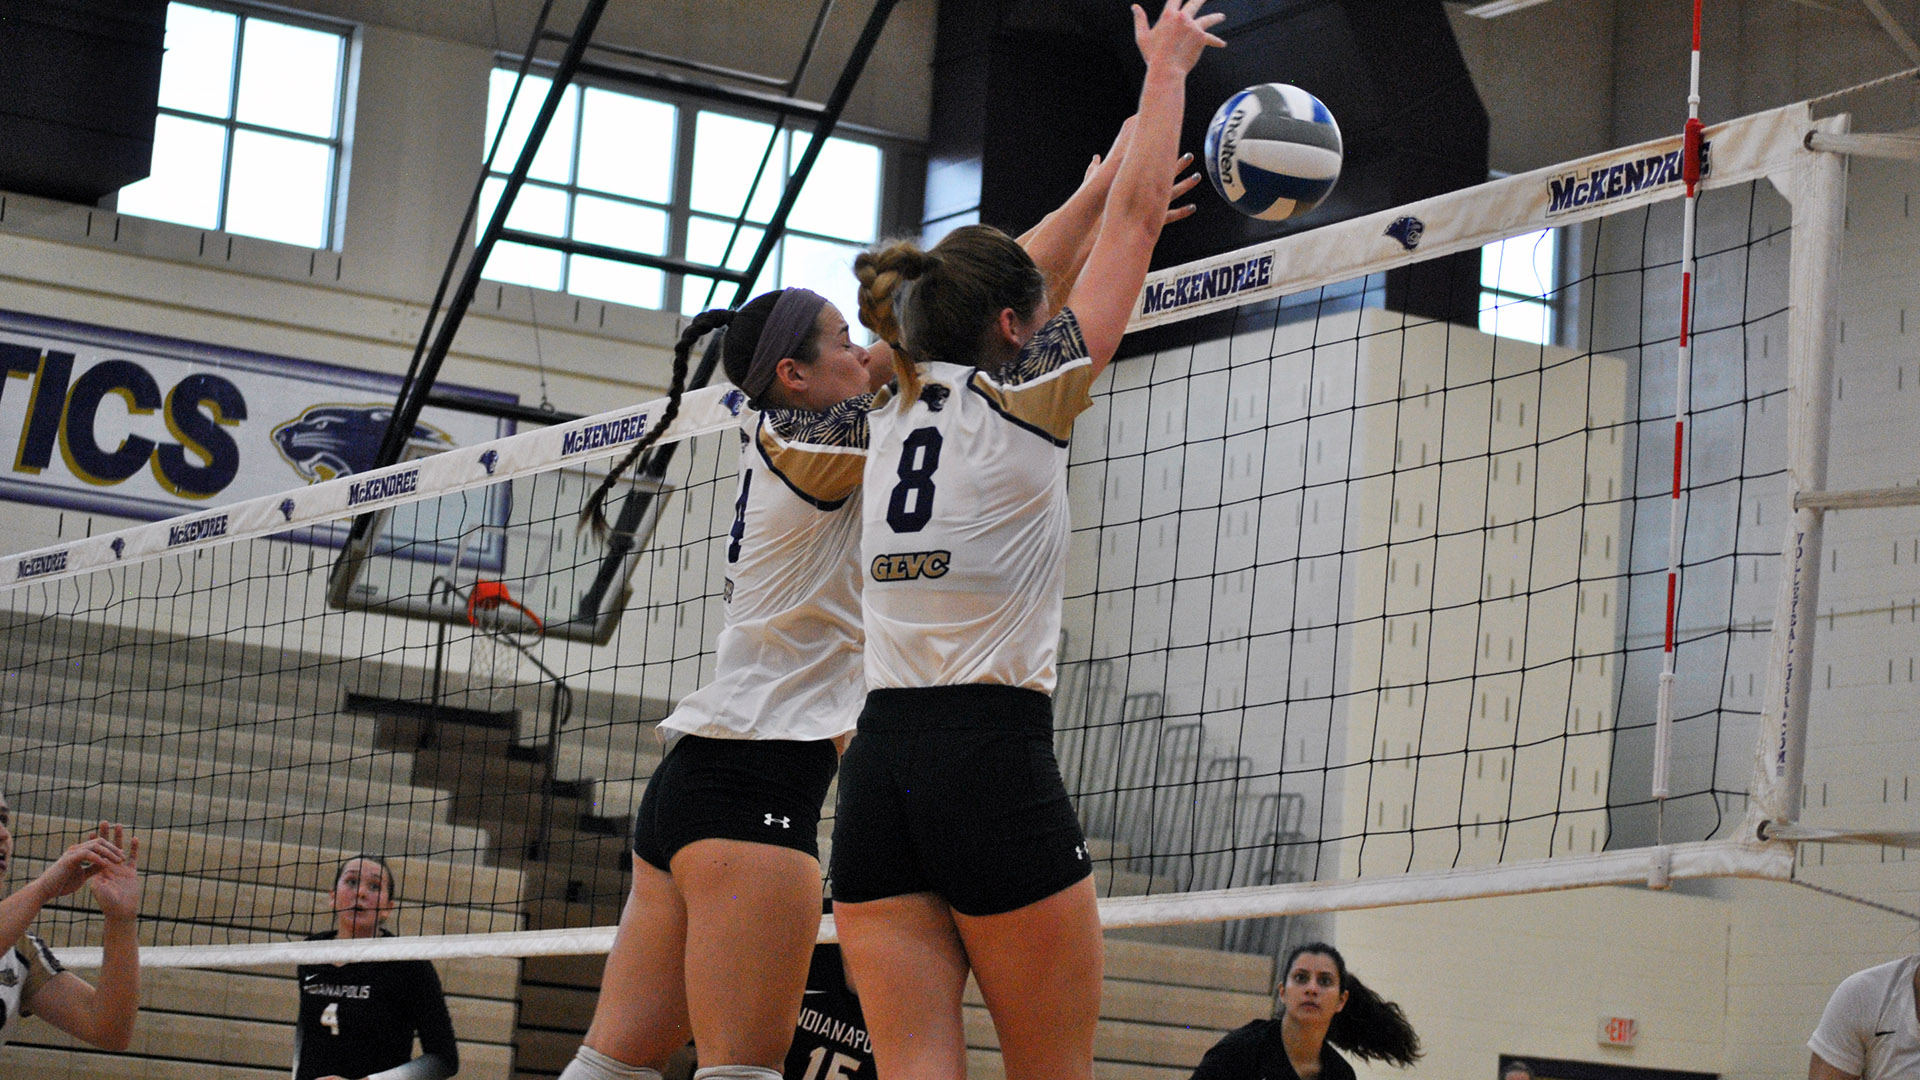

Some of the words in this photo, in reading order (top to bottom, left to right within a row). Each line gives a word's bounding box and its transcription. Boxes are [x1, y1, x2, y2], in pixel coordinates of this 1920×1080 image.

[1221, 109, 1245, 184] molten
[1549, 140, 1712, 212] McKENDRE
[1143, 255, 1273, 314] McKENDREE
[562, 414, 648, 456] McKENDREE
[348, 469, 419, 506] McKENDREE
[886, 426, 944, 534] 8
[168, 514, 229, 547] McKENDREE
[871, 549, 951, 582] GLVC
[321, 1003, 340, 1036] 4
